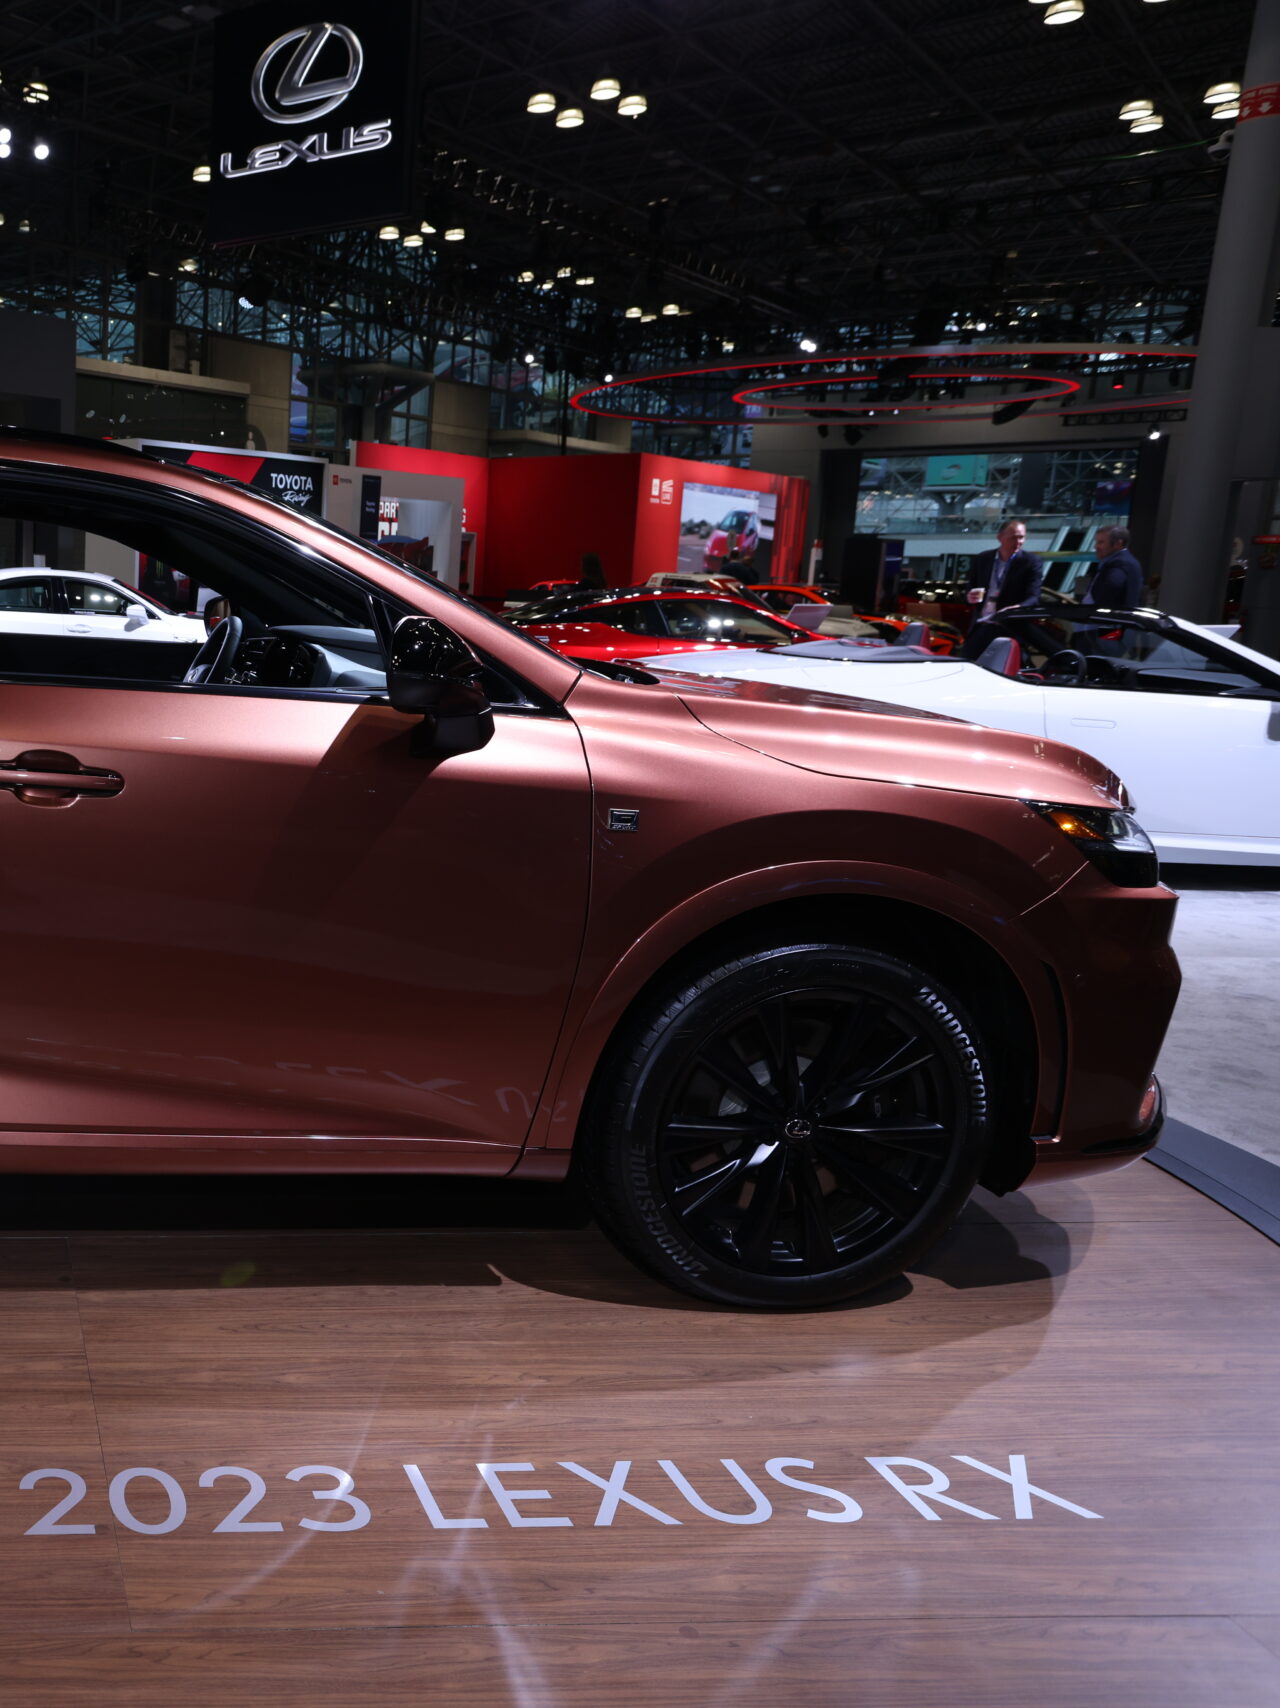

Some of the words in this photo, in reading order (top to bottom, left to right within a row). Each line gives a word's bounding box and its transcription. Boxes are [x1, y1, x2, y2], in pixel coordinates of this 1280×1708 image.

[220, 118, 392, 178] LEXUS
[270, 473, 313, 491] TOYOTA
[915, 986, 988, 1128] BRIDGESTONE
[18, 1465, 371, 1535] 2023
[403, 1457, 863, 1529] LEXUS
[864, 1455, 1104, 1520] RX
